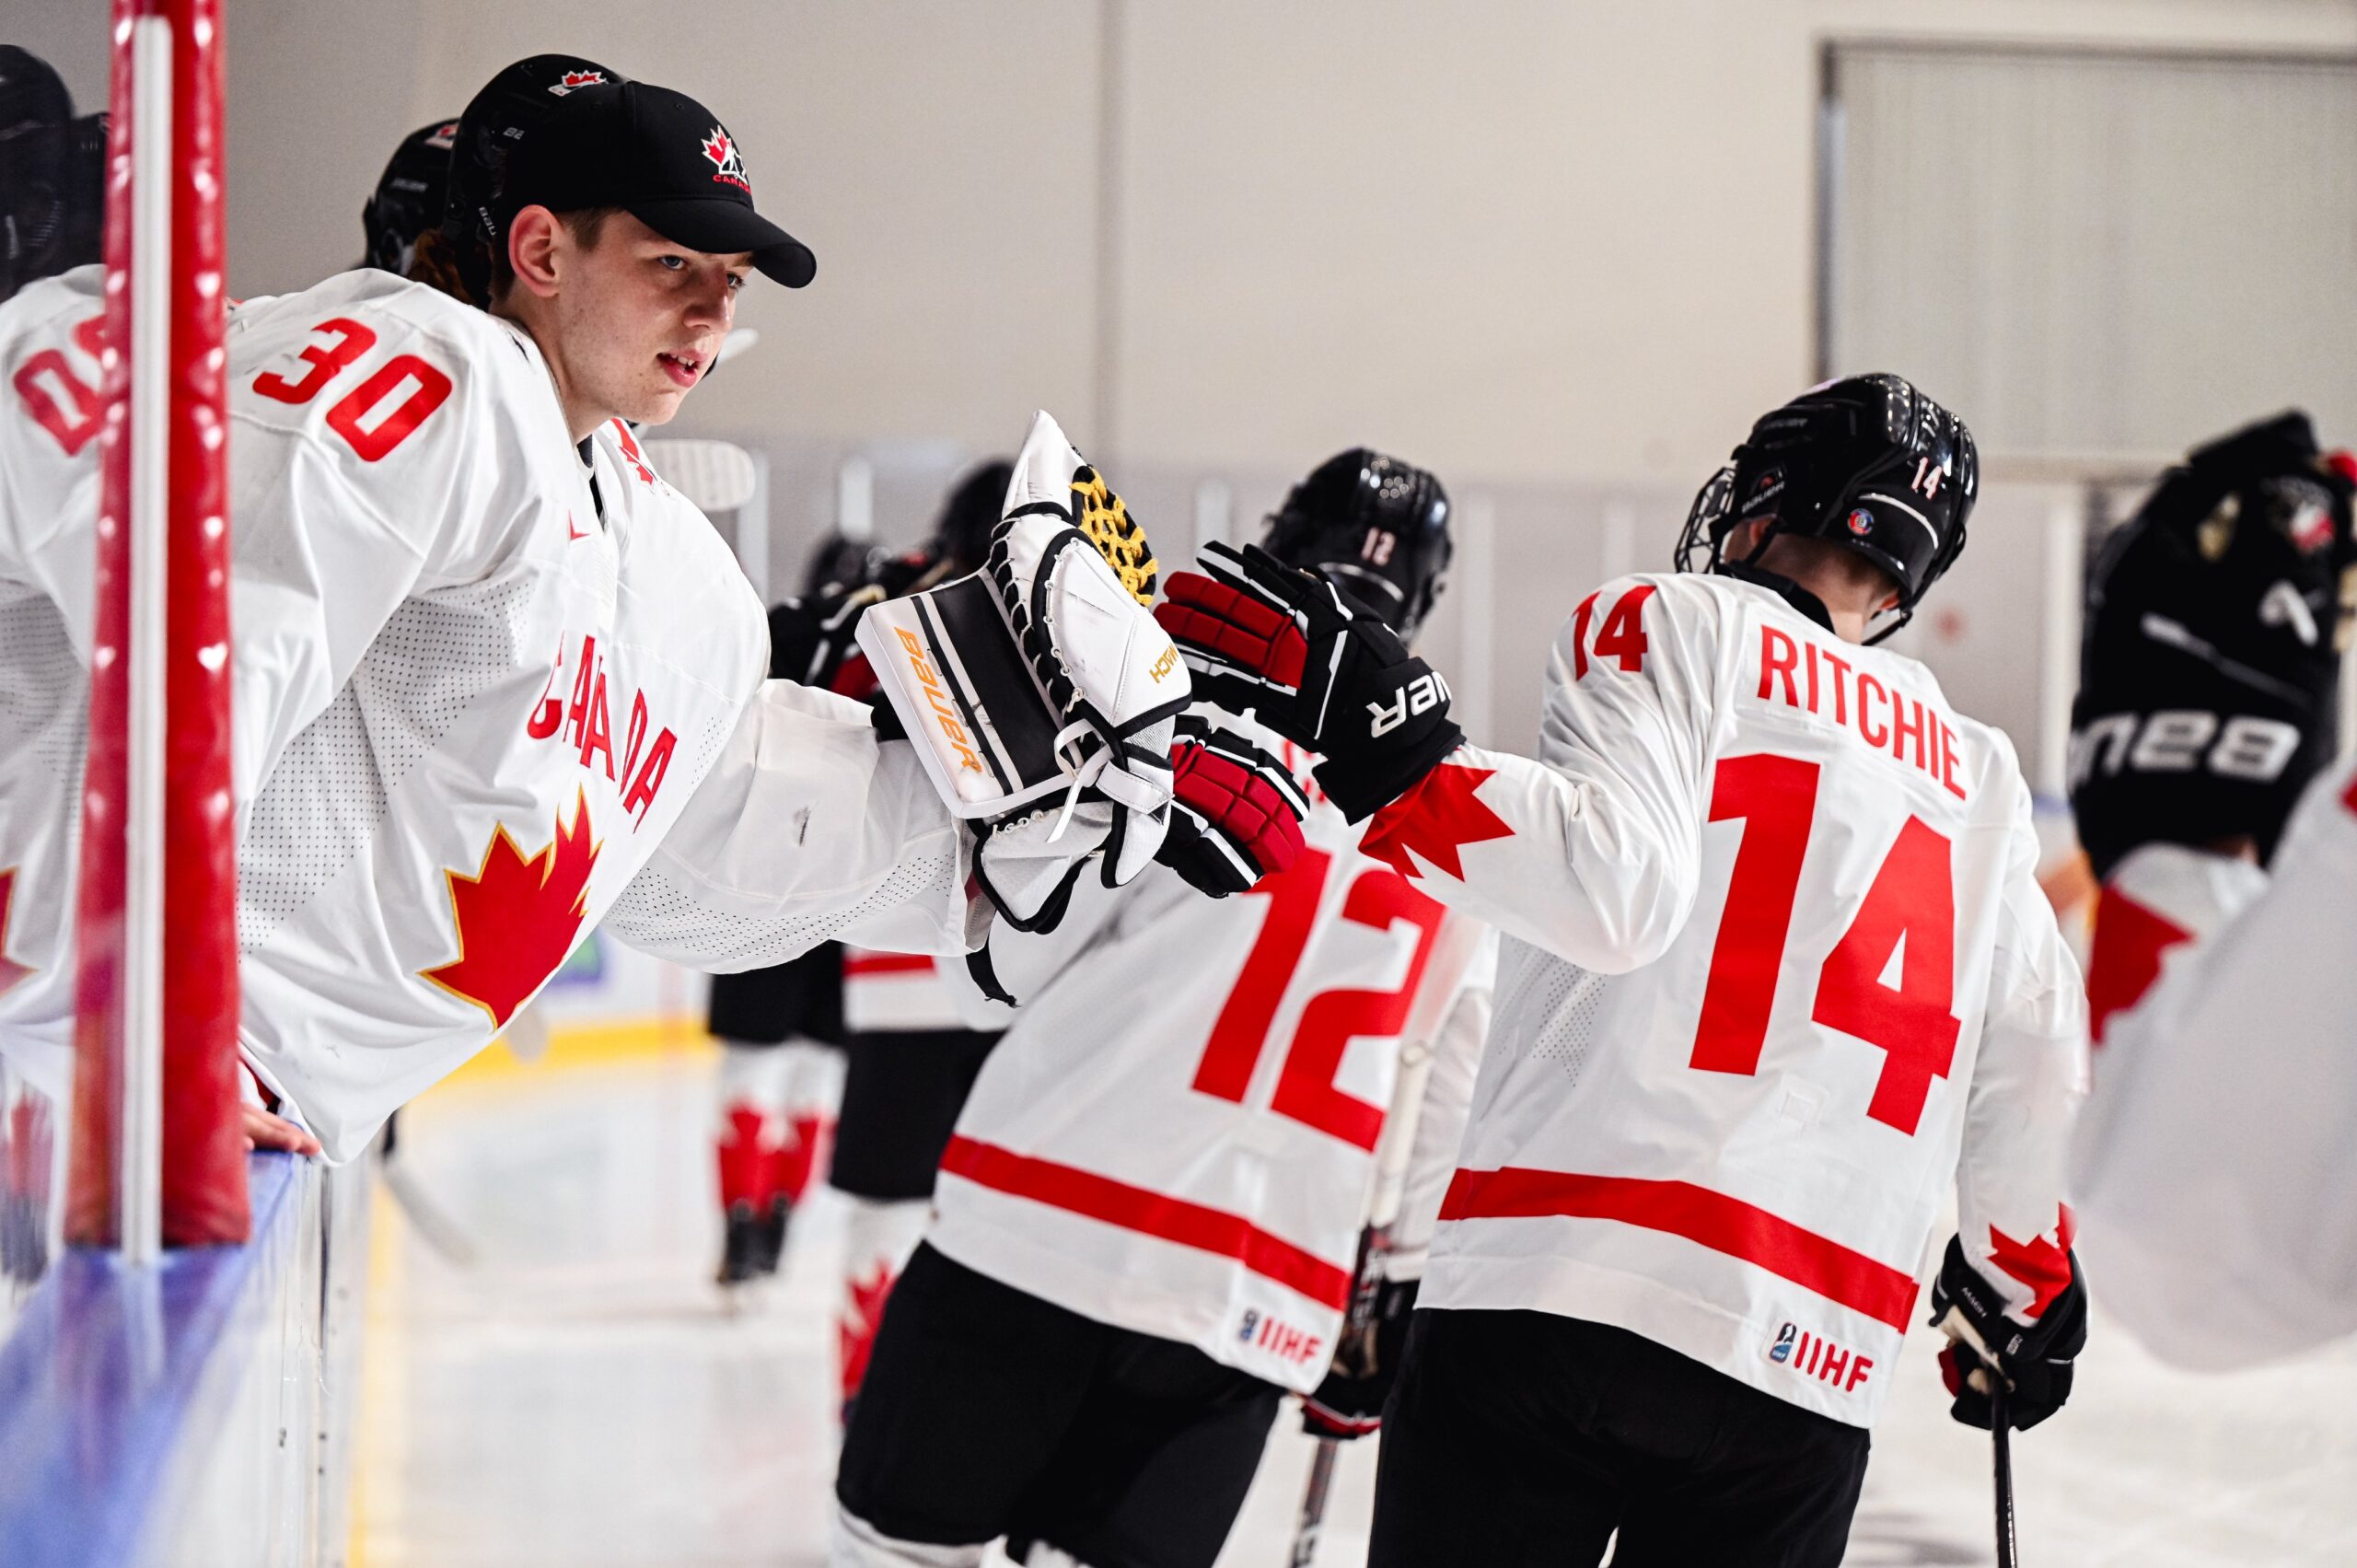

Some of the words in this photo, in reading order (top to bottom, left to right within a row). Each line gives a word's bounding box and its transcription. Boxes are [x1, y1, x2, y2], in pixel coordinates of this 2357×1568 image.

[253, 318, 451, 462] 30
[1911, 457, 1943, 501] 14
[1361, 526, 1397, 567] 12
[1149, 642, 1178, 684] MACH
[1573, 585, 1656, 680] 14
[1757, 624, 1967, 801] RITCHIE
[1689, 753, 1962, 1136] 14
[1191, 846, 1446, 1153] 12
[1258, 1317, 1323, 1365] IIHF
[1794, 1331, 1874, 1392] IIHF
